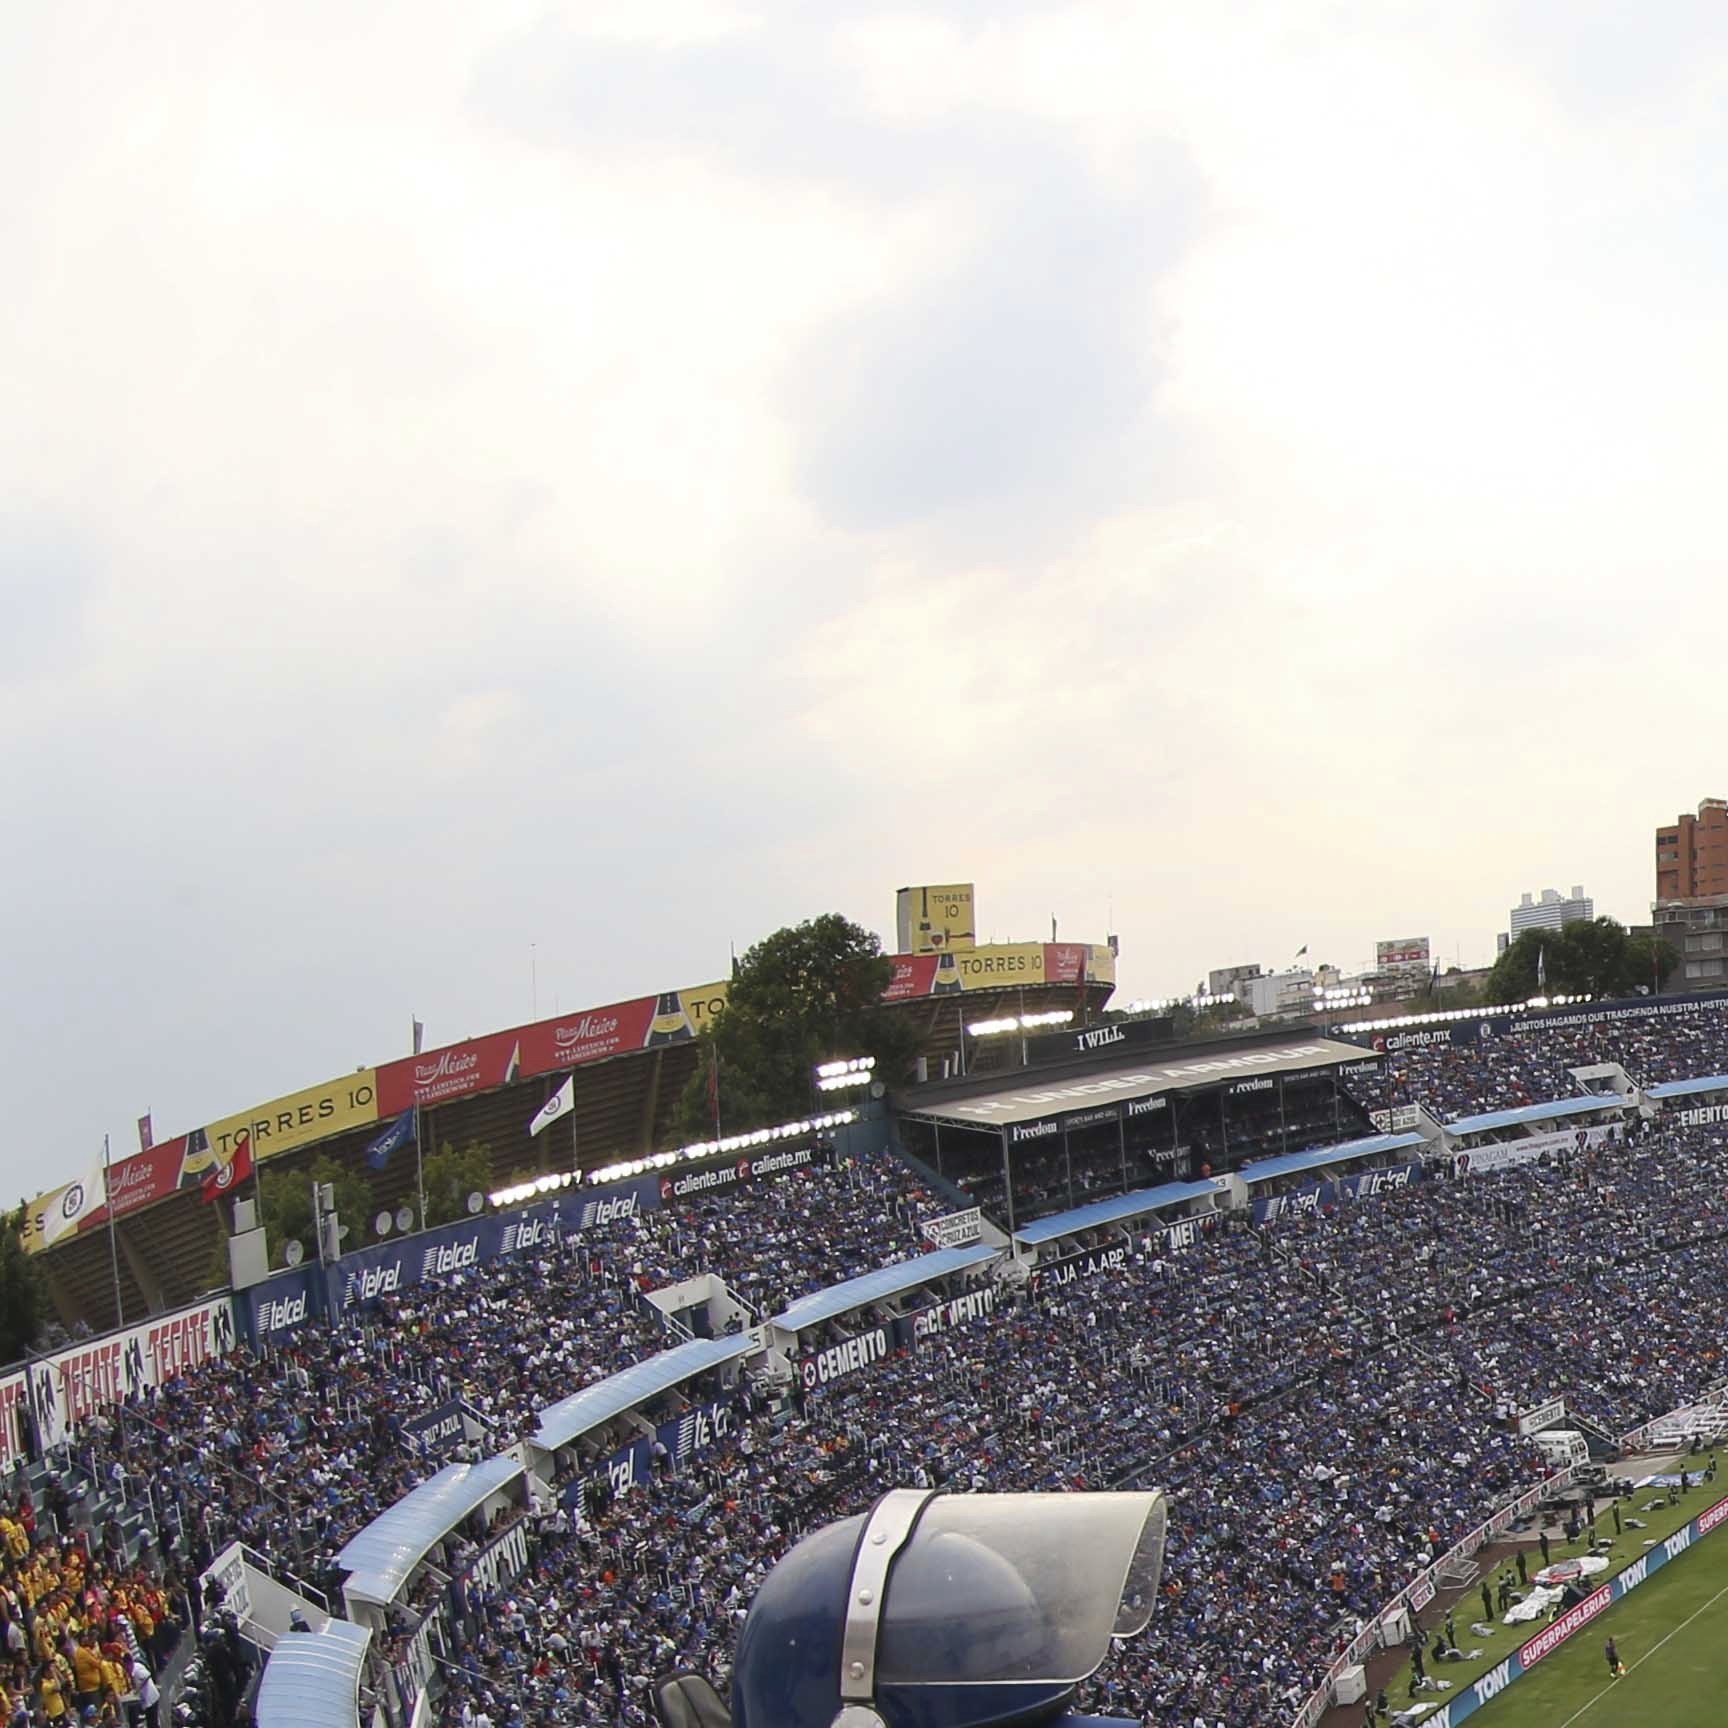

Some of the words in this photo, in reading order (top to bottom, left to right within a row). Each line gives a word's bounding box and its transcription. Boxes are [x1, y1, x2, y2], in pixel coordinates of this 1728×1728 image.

[961, 956, 1025, 975] TORRES
[1545, 1014, 1587, 1028] HAGAMOS
[1589, 1011, 1606, 1022] QUE
[1606, 1005, 1659, 1020] TRASCIENDA
[1659, 1002, 1701, 1015] NUESTRA
[1387, 1030, 1451, 1050] caliente.mx
[1010, 1070, 1165, 1104] UNDER
[1161, 1043, 1331, 1079] ARMOUR
[1339, 1060, 1379, 1077] Freedom
[1128, 1097, 1167, 1116] Freedom
[217, 1100, 334, 1154] TORRES
[1013, 1121, 1057, 1142] Freedom
[751, 1149, 812, 1176] caliente.mx
[673, 1165, 737, 1197] caliente.mx
[595, 1191, 637, 1225] telcel
[436, 1236, 479, 1274] telcel
[269, 1290, 307, 1331] telcel
[817, 1328, 886, 1385] CEMENTO
[1663, 1525, 1691, 1561] TONY
[1619, 1556, 1648, 1595] TONY
[1521, 1585, 1612, 1667] SUPERPAPELERIAS
[1473, 1661, 1511, 1707] TONY
